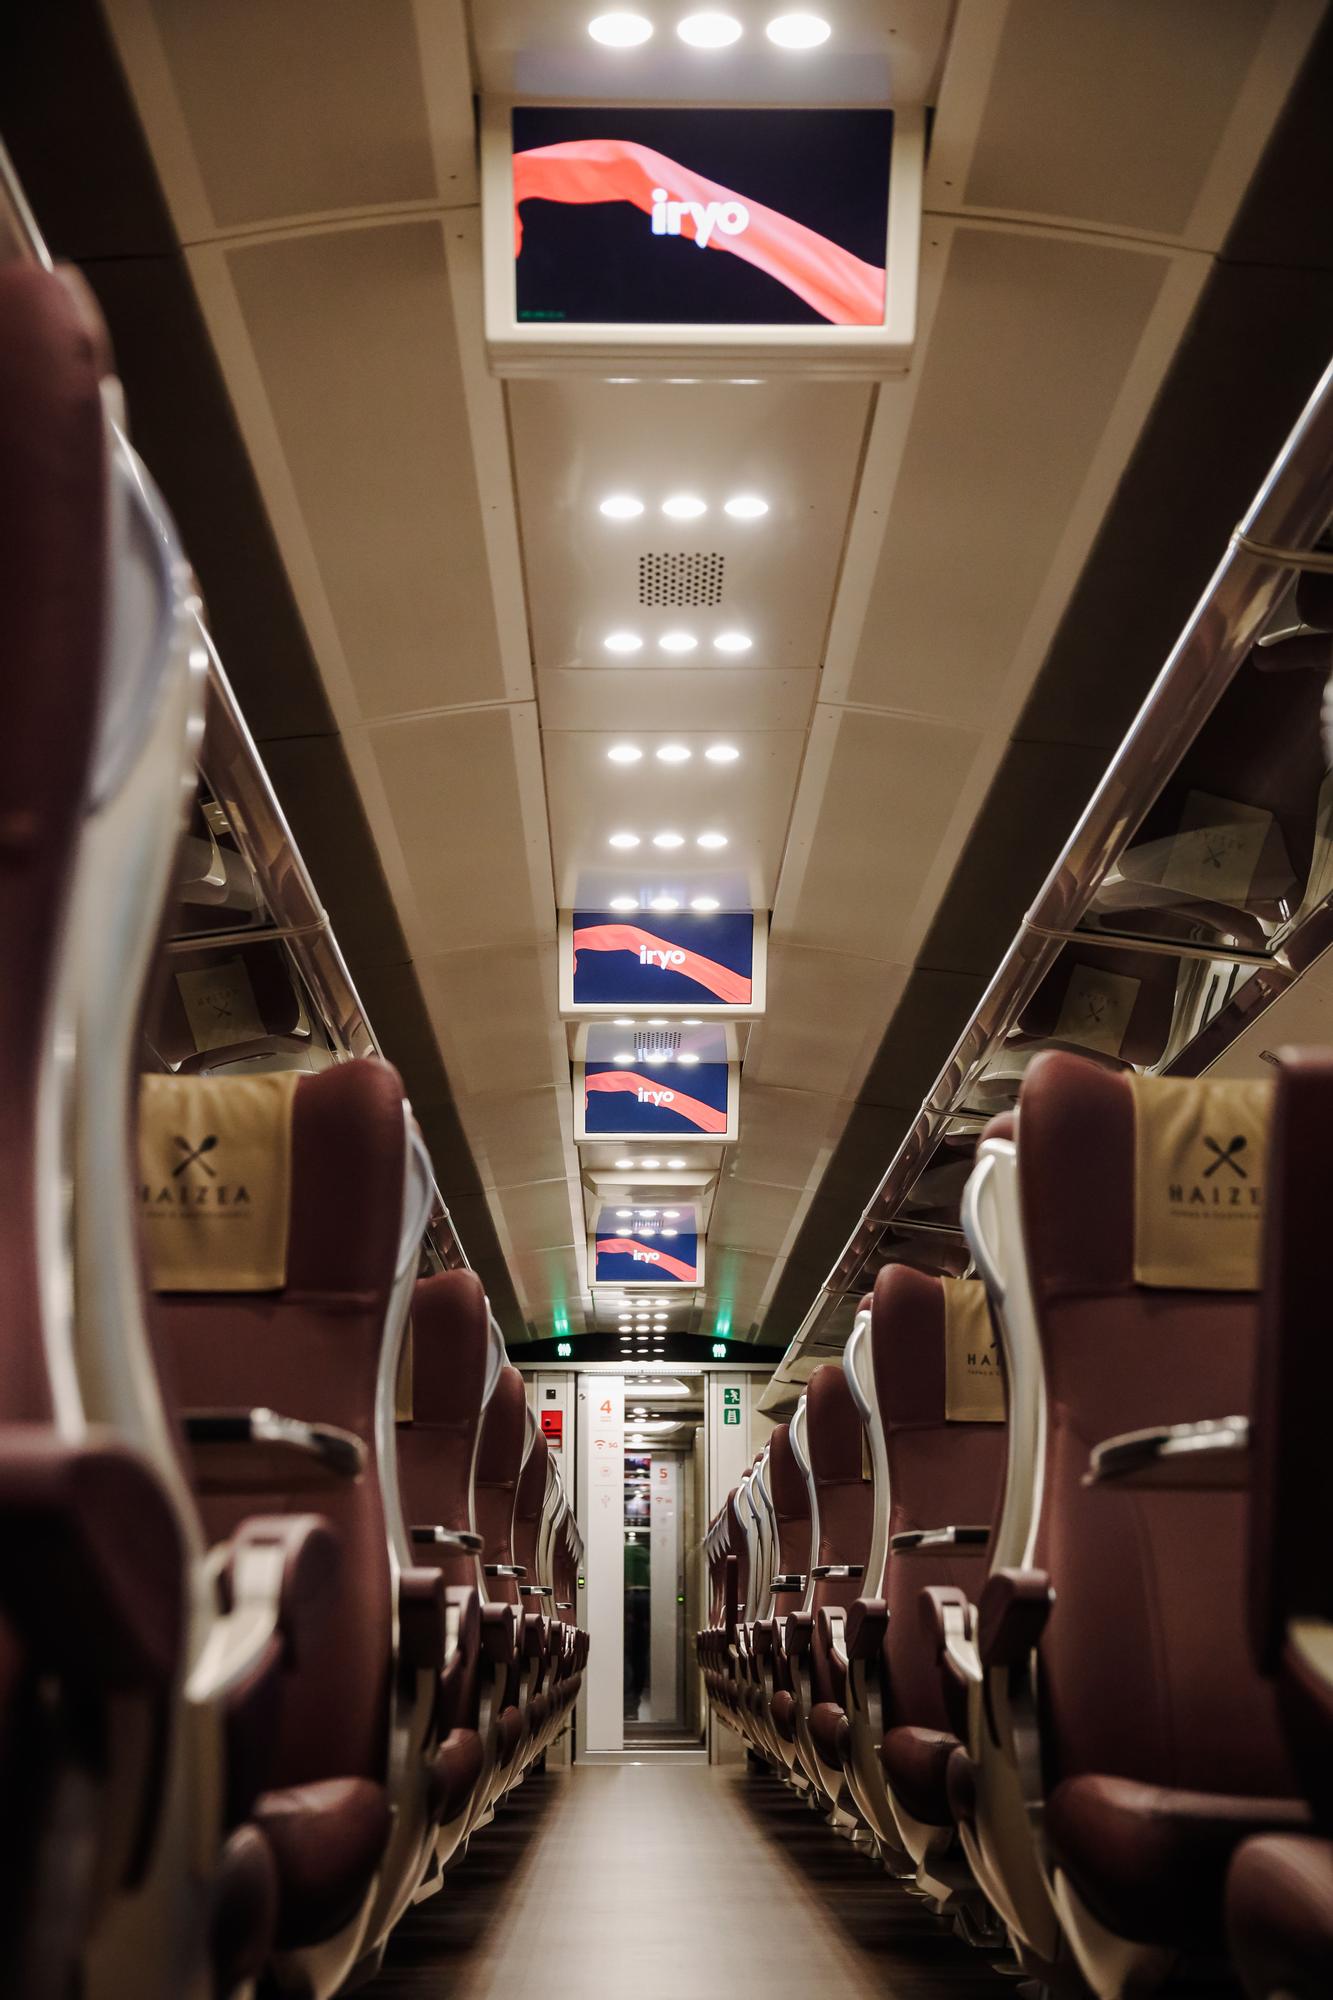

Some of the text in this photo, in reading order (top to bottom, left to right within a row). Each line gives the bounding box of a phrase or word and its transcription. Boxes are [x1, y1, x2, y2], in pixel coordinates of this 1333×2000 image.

[651, 188, 750, 249] iryo
[639, 944, 686, 969] iryo
[637, 1087, 675, 1106] iryo
[1168, 1184, 1262, 1206] HAIZE
[633, 1249, 660, 1263] iryo
[600, 1400, 612, 1414] 4
[659, 1468, 668, 1479] 5
